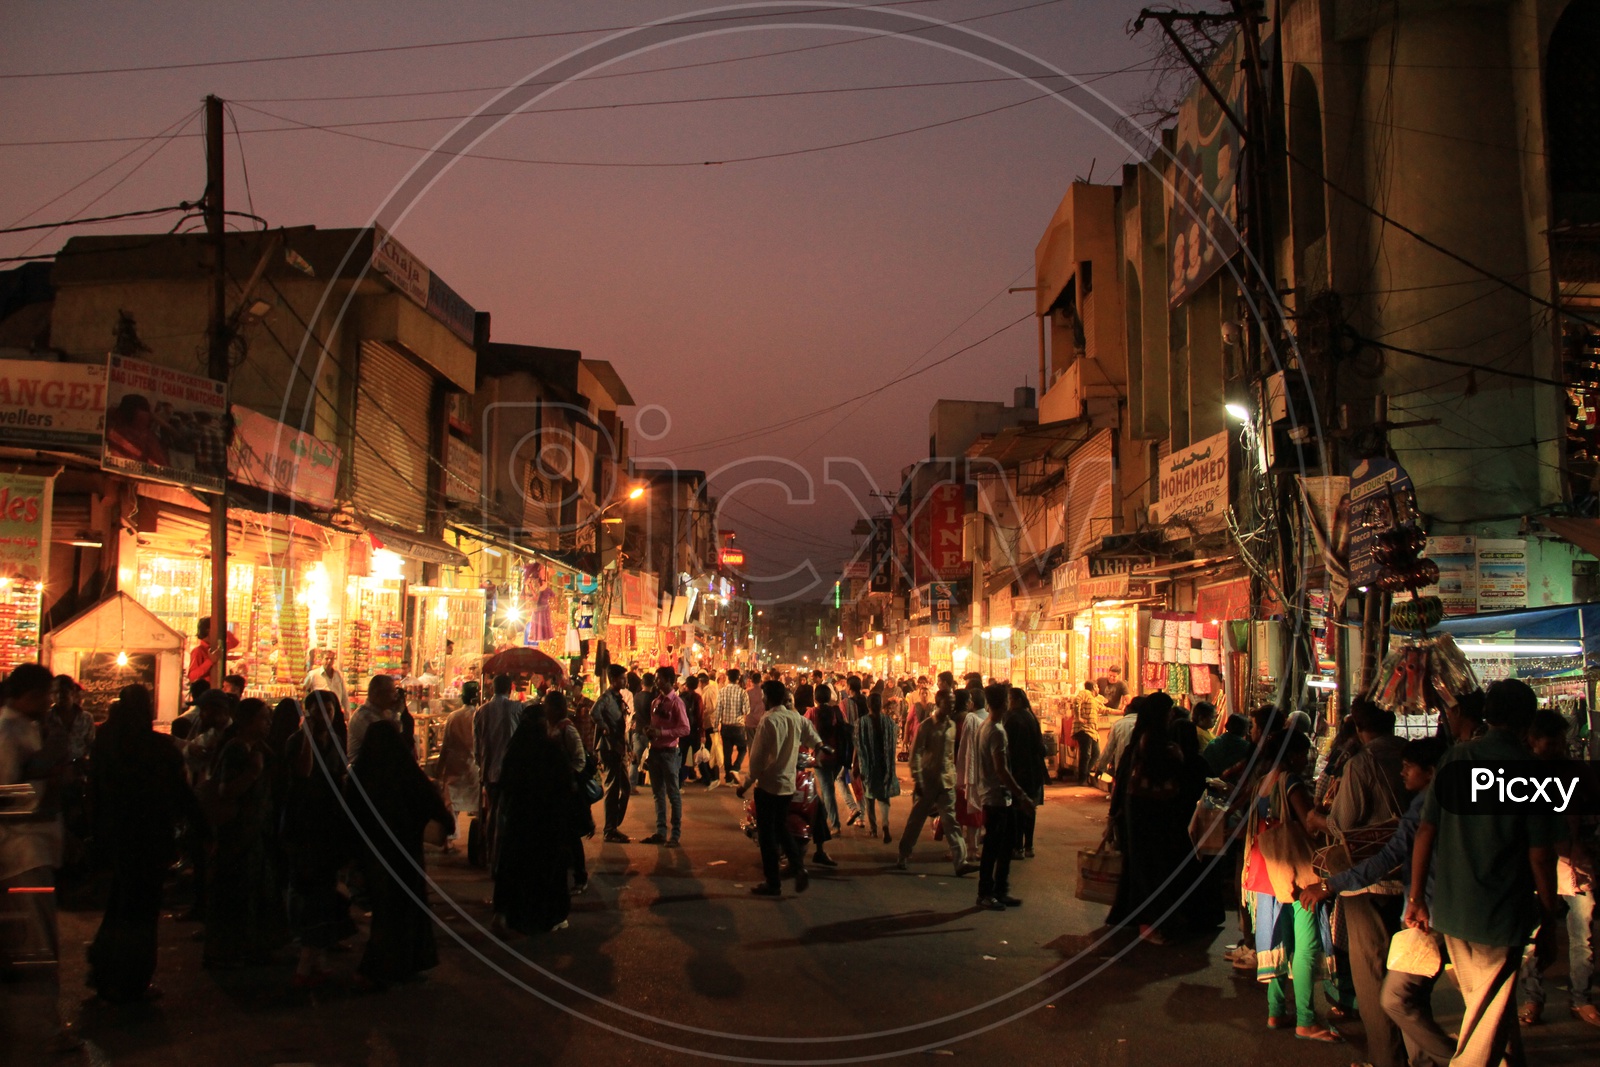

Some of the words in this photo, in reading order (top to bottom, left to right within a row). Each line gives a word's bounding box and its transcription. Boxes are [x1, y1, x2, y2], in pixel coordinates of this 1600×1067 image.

[381, 240, 420, 283] Khaja
[111, 368, 126, 384] BAG
[128, 372, 156, 392] LIFTERS
[162, 381, 184, 399] CHAIN
[186, 387, 225, 409] SNATCHERS
[1170, 445, 1212, 473] محمد
[1161, 457, 1227, 500] MOHAMMED
[1353, 485, 1361, 498] AP
[1363, 470, 1395, 493] TOURISM
[1194, 484, 1220, 503] CENTRE
[939, 484, 962, 568] FINE
[1351, 531, 1371, 545] Mecca
[876, 520, 888, 585] KHALID
[1350, 557, 1372, 572] Gulzar
[1052, 566, 1077, 592] Akhter
[1091, 558, 1150, 576] Akhter
